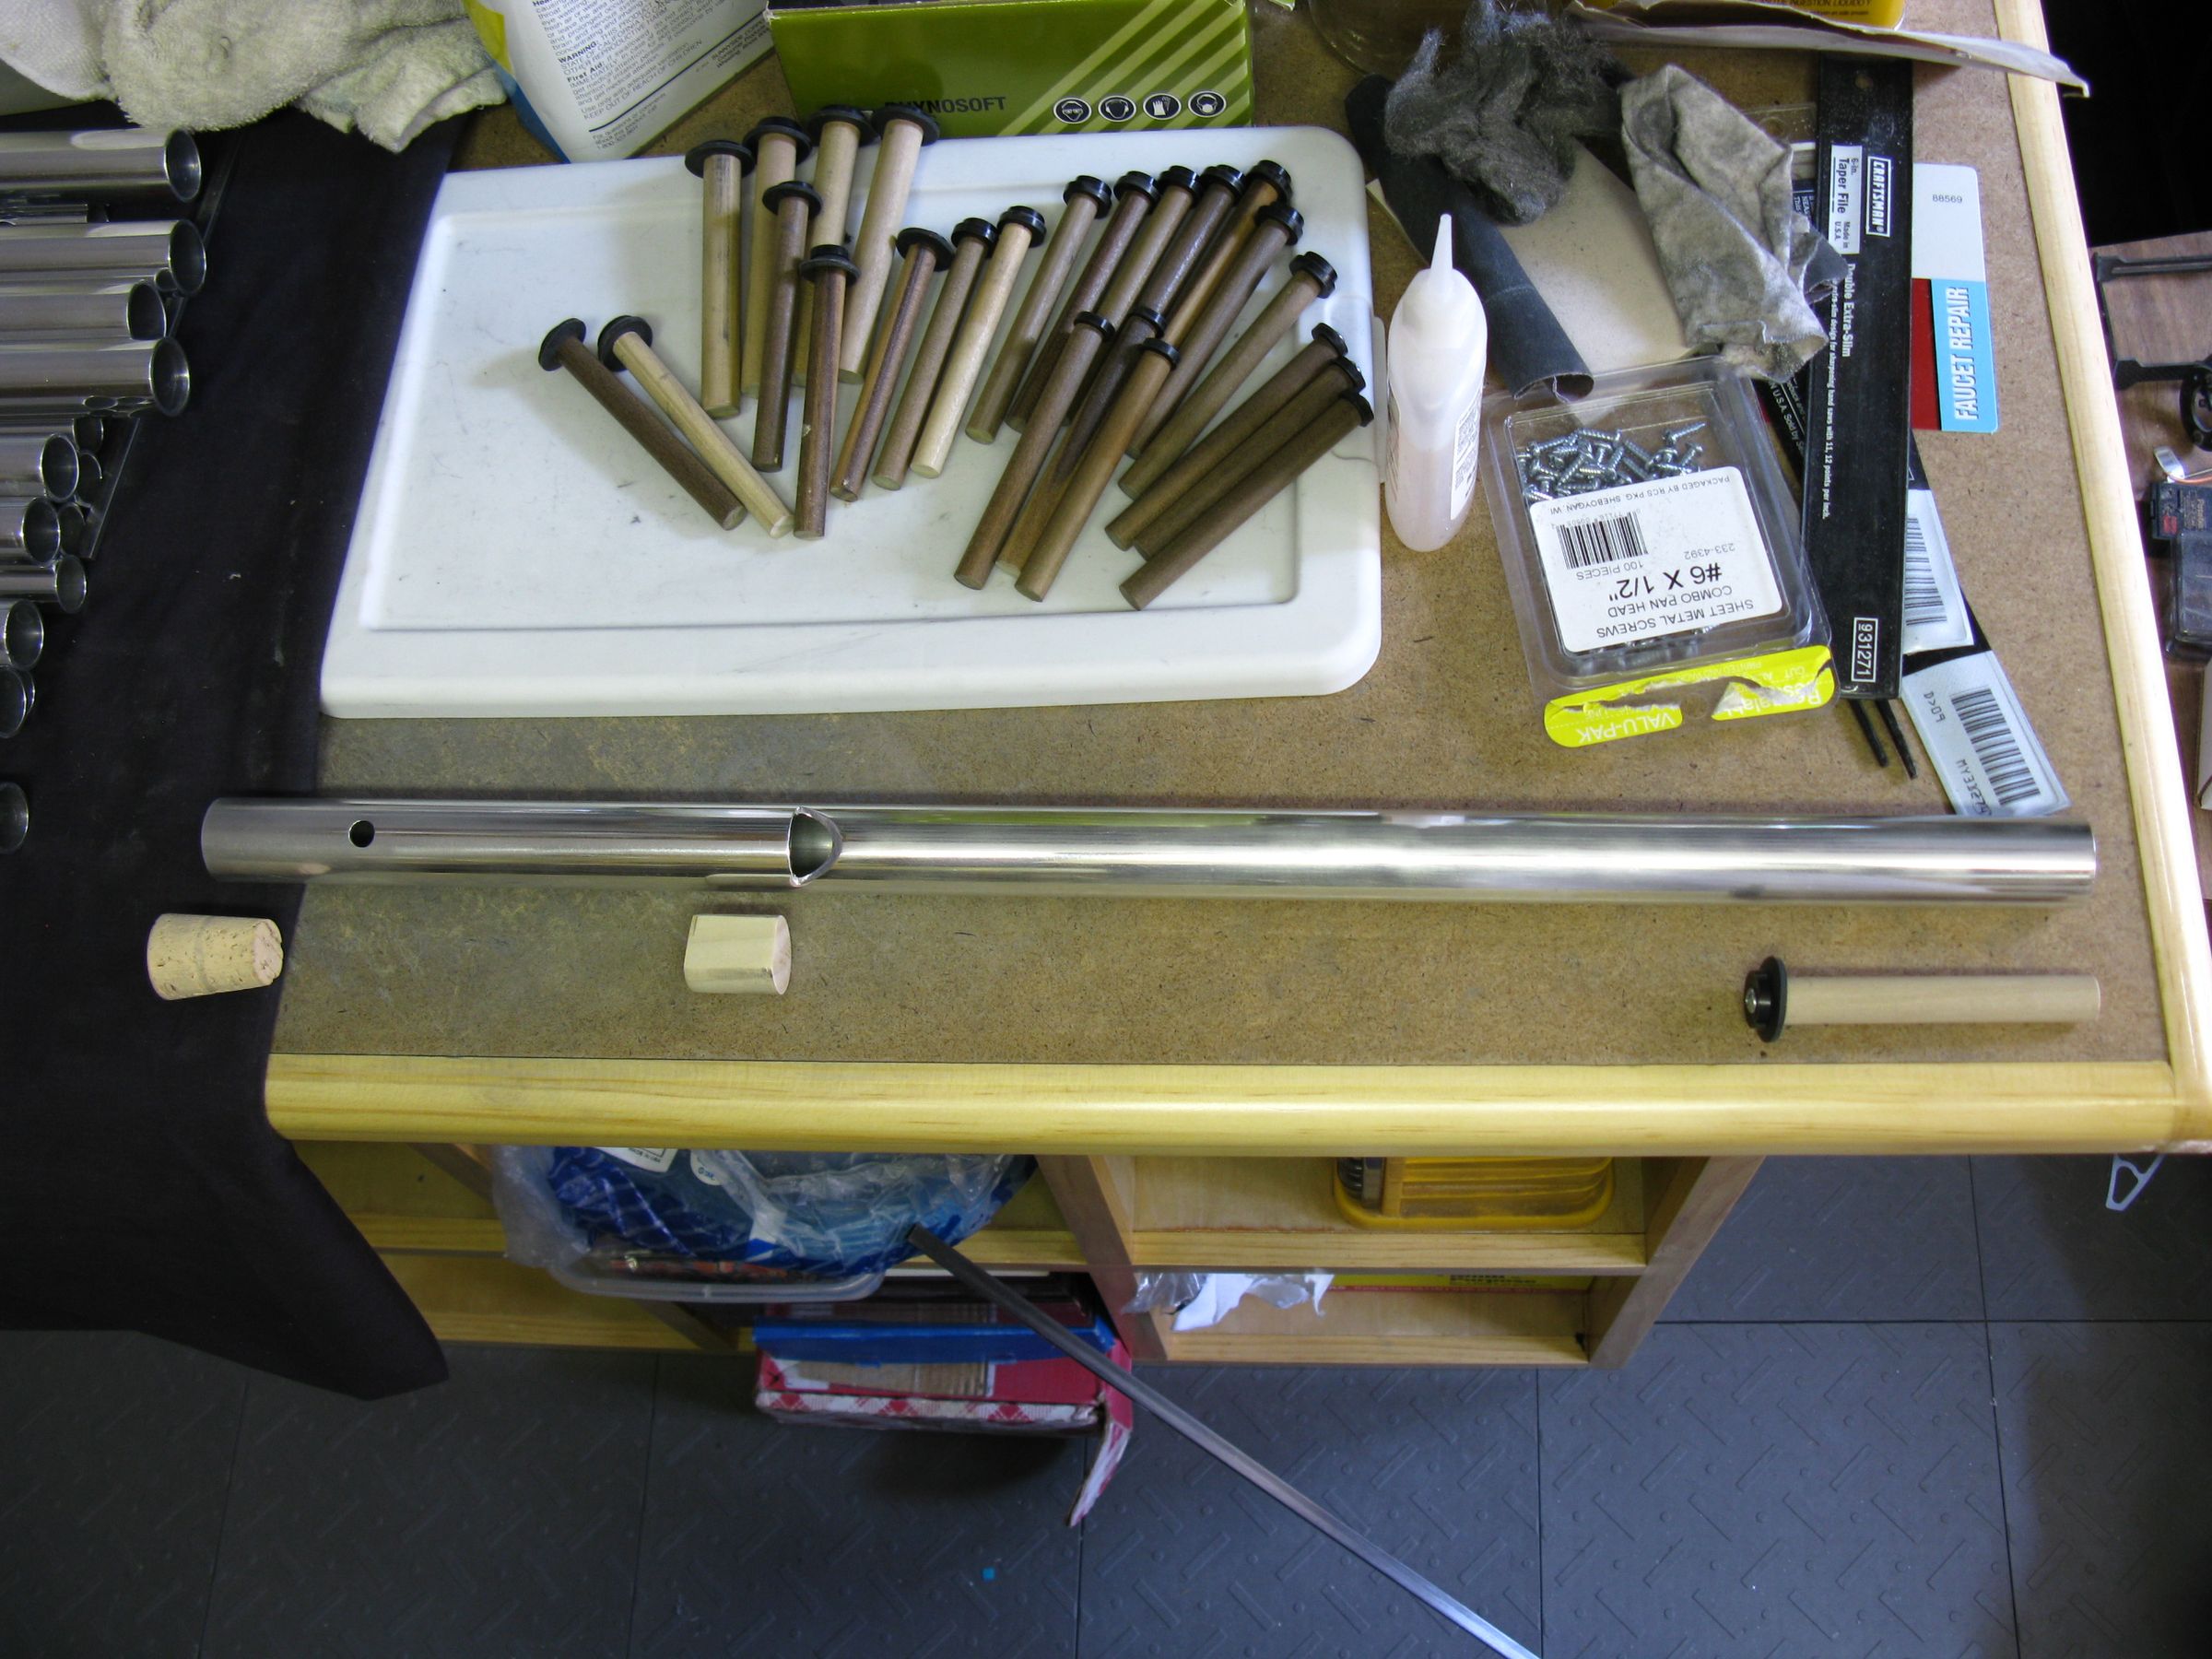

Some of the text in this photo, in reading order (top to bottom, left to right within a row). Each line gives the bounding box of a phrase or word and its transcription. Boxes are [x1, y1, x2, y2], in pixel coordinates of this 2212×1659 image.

[566, 67, 588, 86] First
[1836, 157, 1849, 213] Taper File
[1932, 194, 1962, 203] 88569
[1841, 301, 1854, 357] Extra-Slim
[1828, 341, 1836, 351] for
[1945, 285, 1978, 420] FAUCET REPAIR
[1824, 352, 1836, 388] sharpening
[1826, 389, 1834, 406] hand
[1783, 412, 1797, 431] Sold
[1825, 406, 1833, 424] saws
[1825, 425, 1833, 440] with
[1822, 441, 1832, 453] 11,
[1824, 453, 1832, 464] 12
[1680, 475, 1730, 490] PACKAGED
[1821, 465, 1831, 487] points
[1645, 486, 1665, 497] RCS
[1666, 483, 1679, 493] BY
[1820, 488, 1830, 500] per
[1682, 541, 1735, 559] 233-4392
[1574, 559, 1643, 580] 100 PIECES
[1606, 560, 1723, 602] #6 X 1/2"
[1606, 583, 1732, 618] COMBO PAN HEAD
[1594, 598, 1754, 639] SHEET METAL SCREWS
[1856, 623, 1873, 675] 931271
[1575, 710, 1675, 742] VALU-PAK
